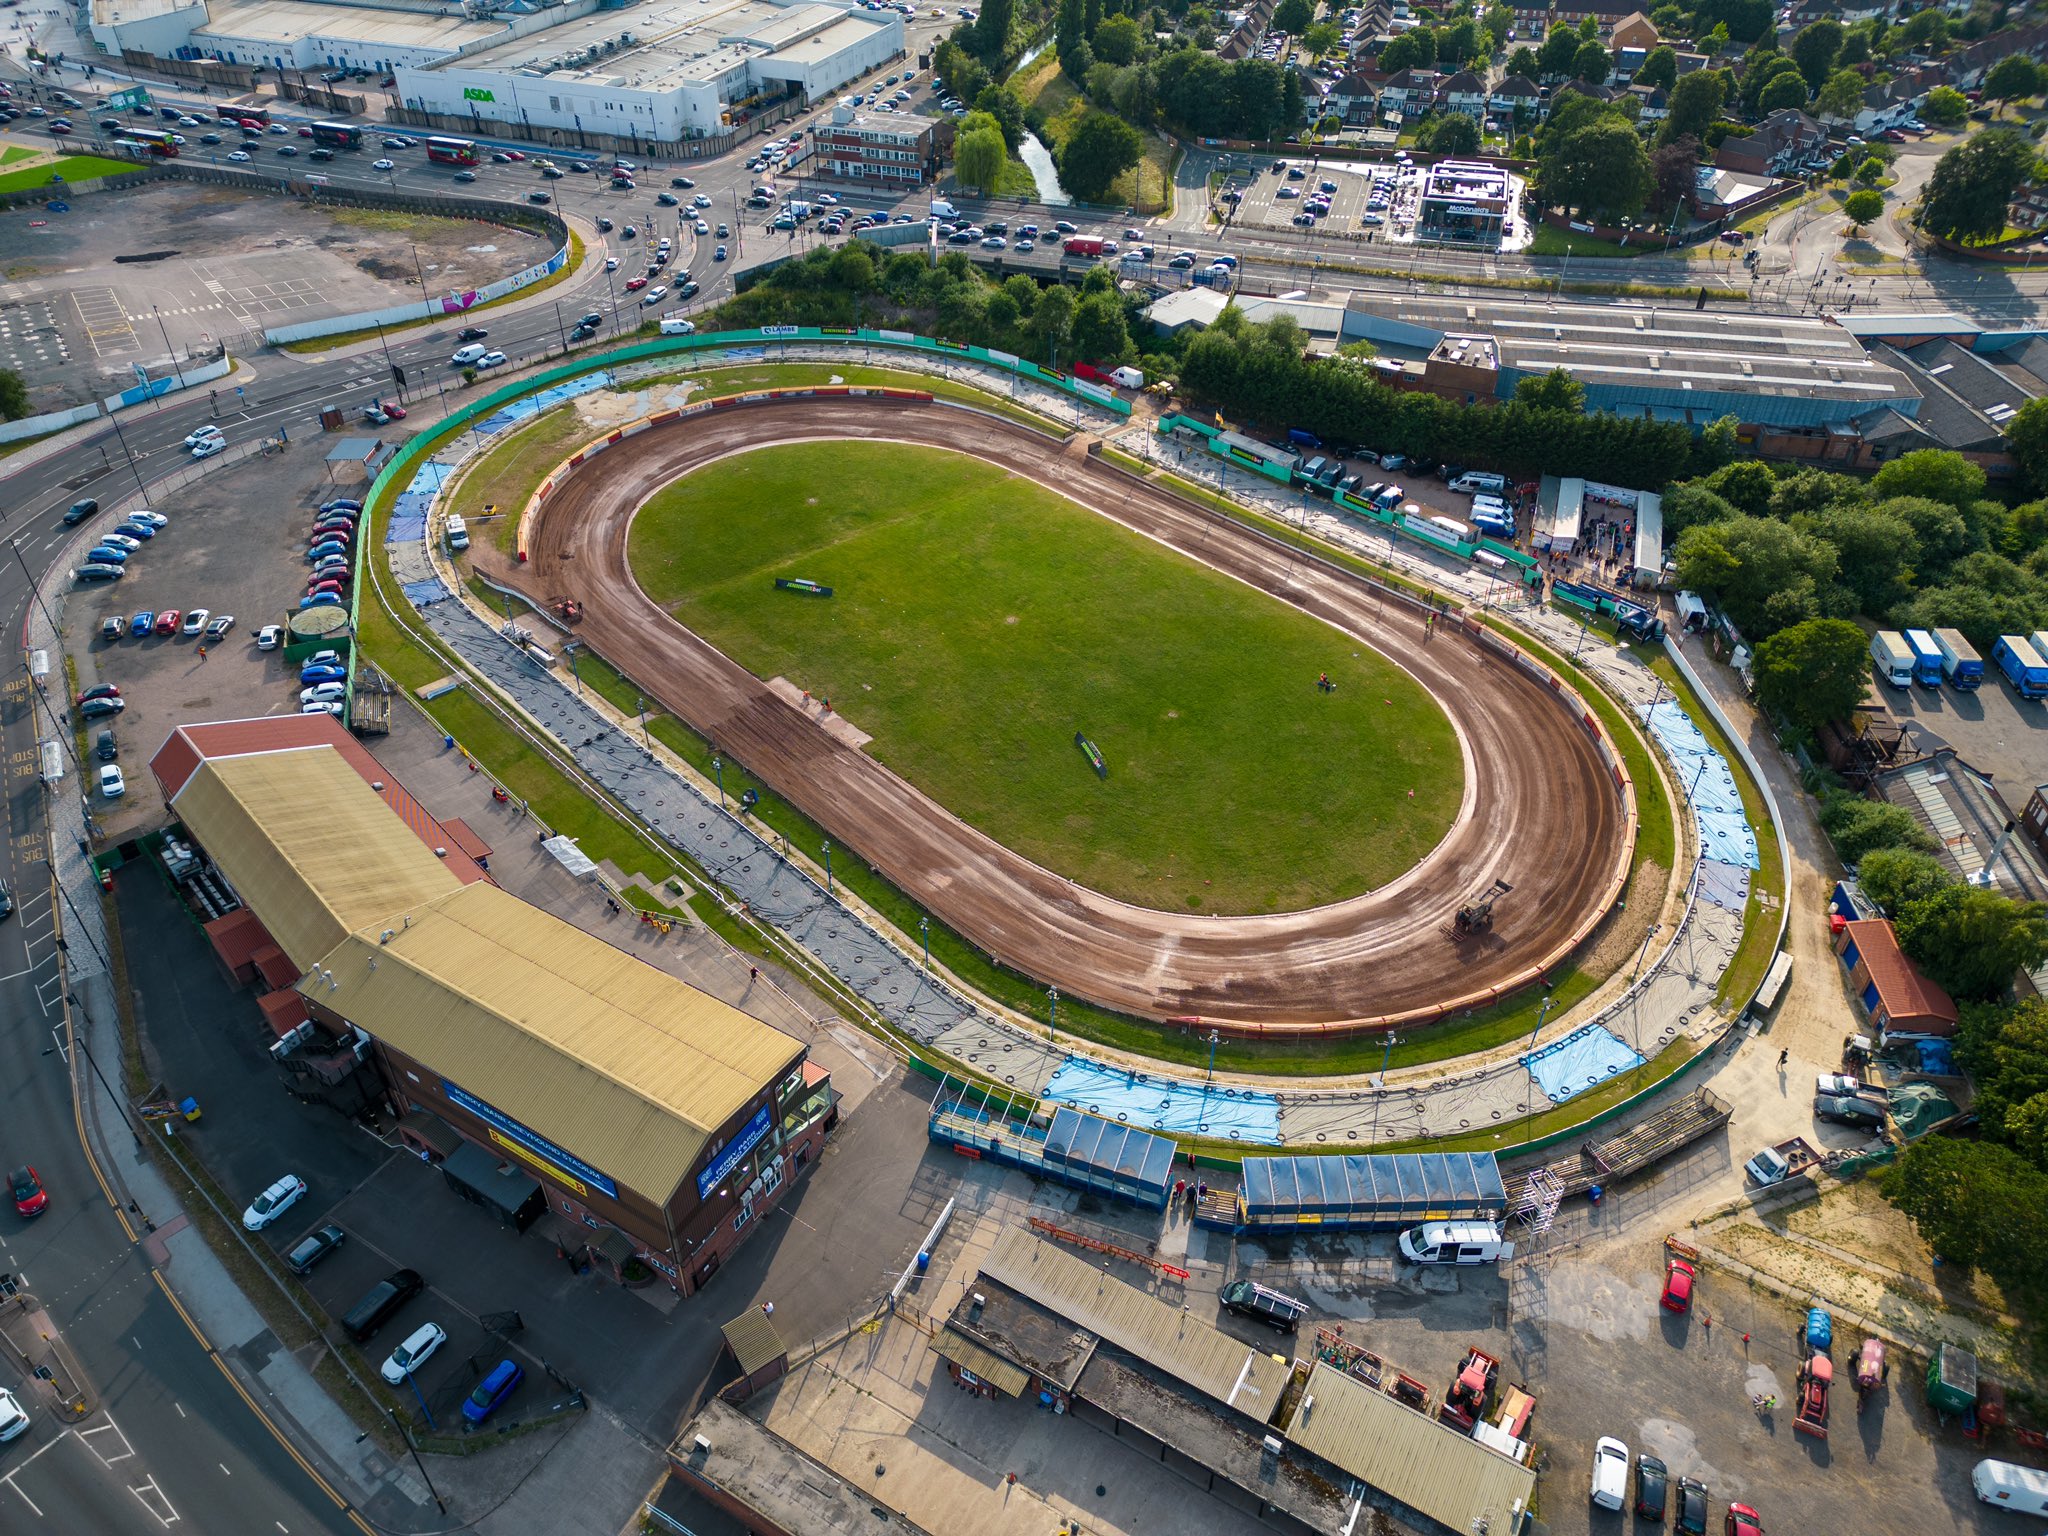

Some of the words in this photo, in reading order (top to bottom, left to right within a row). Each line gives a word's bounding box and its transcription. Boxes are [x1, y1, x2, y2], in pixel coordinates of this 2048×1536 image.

[463, 87, 496, 103] ASDA
[1449, 204, 1490, 214] McDonald's
[9, 750, 34, 763] STOP
[13, 763, 33, 778] BUS
[17, 832, 44, 848] STOP
[22, 848, 43, 864] BUS
[454, 1087, 482, 1108] PERRY
[483, 1105, 507, 1123] BARR
[507, 1116, 561, 1156] GREYHOUND
[561, 1152, 601, 1180] STADIUM
[743, 1121, 770, 1150] STADIUM
[715, 1150, 738, 1175] PERRY
[738, 1130, 756, 1151] BARR
